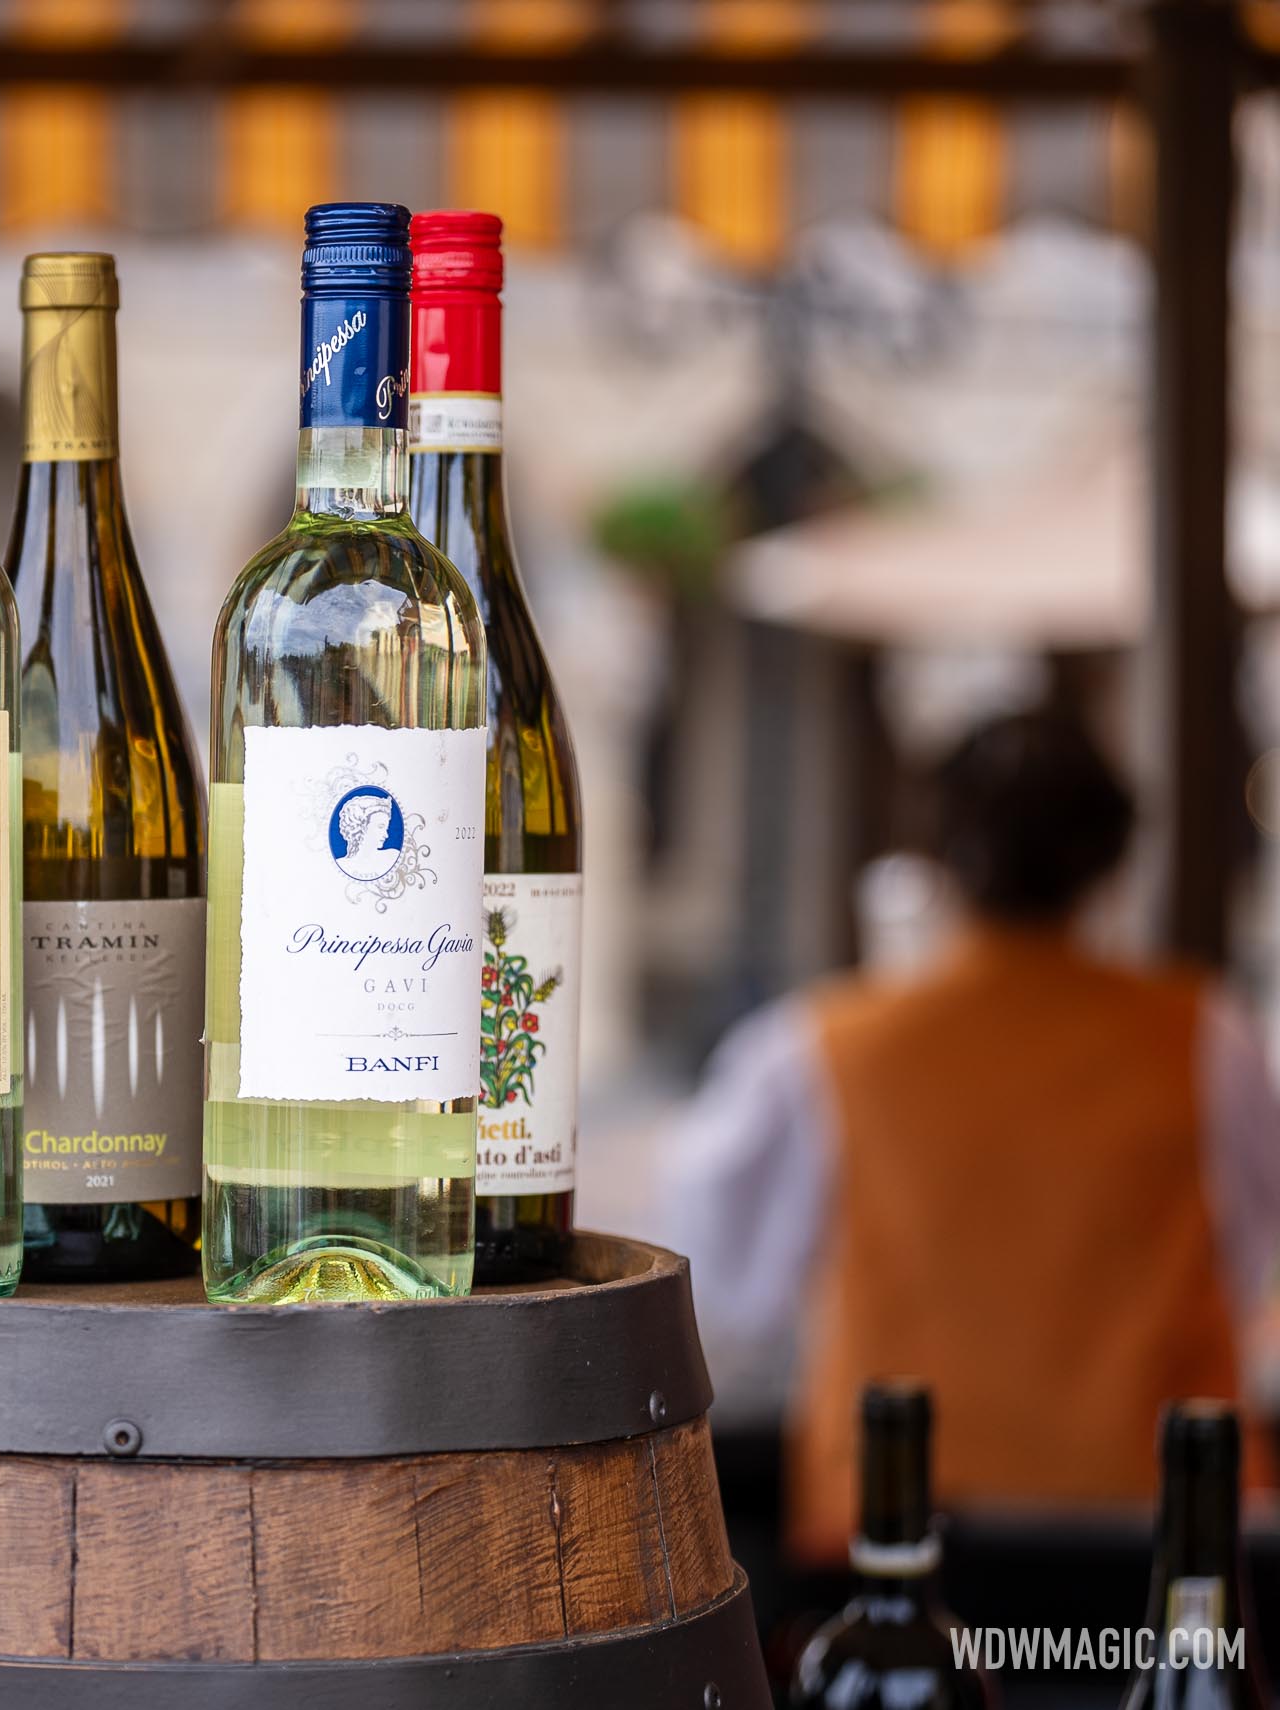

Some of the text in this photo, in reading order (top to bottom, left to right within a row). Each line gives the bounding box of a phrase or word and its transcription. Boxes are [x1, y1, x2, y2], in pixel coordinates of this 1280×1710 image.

[30, 934, 160, 950] TRAMIN
[286, 923, 474, 971] Principessa Gavia
[363, 977, 428, 993] GAVI
[377, 1002, 416, 1012] DOCG
[345, 1056, 440, 1072] BANFI
[478, 1115, 532, 1140] ietti.
[25, 1128, 168, 1157] Chardonnay
[85, 1174, 114, 1188] 2021
